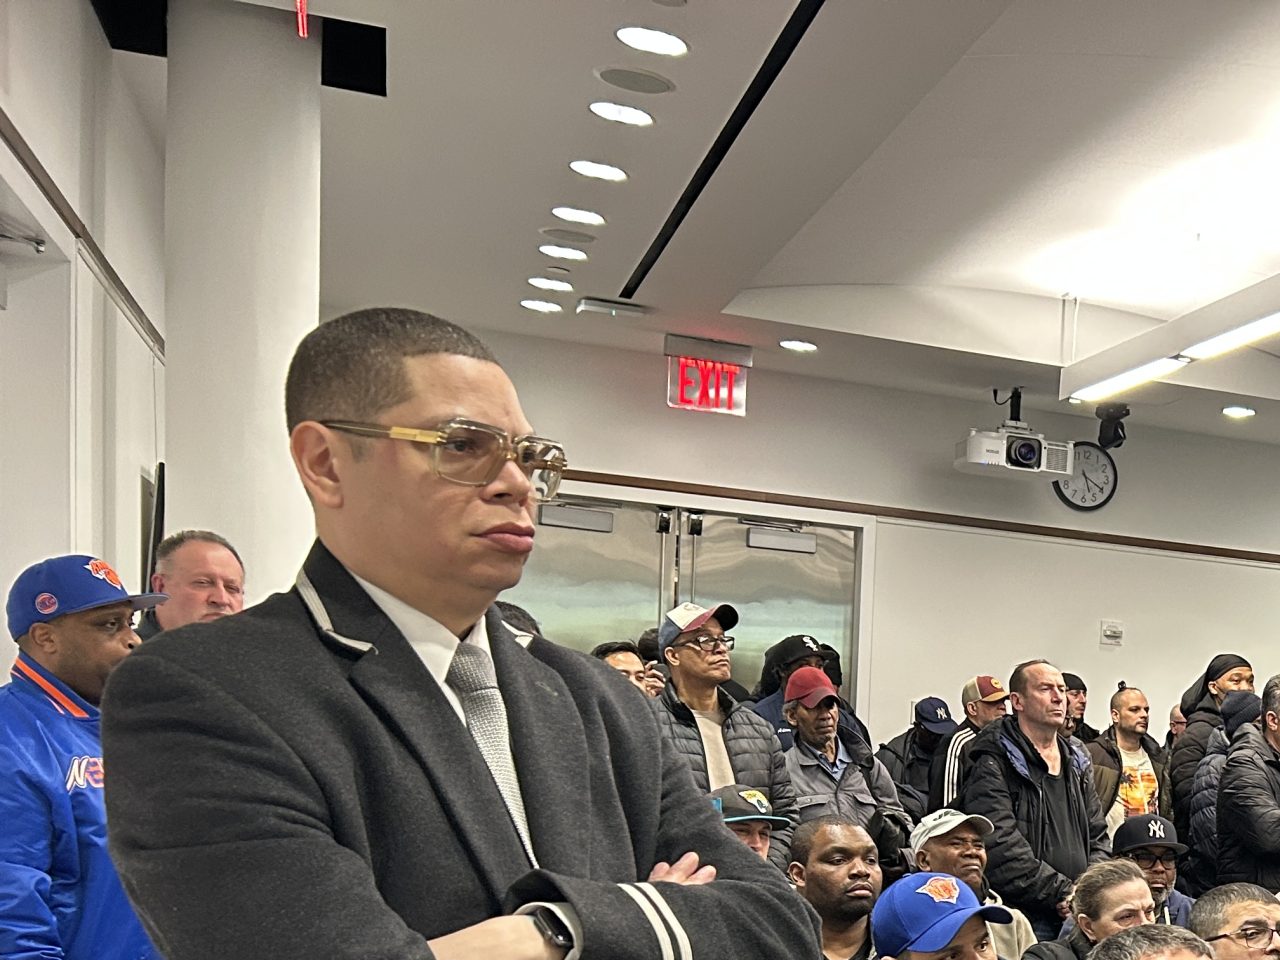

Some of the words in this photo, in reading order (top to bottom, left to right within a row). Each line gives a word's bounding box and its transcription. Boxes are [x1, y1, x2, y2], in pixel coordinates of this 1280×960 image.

[678, 356, 740, 411] EXIT
[1083, 450, 1091, 460] 12
[1101, 464, 1107, 473] 2
[1063, 480, 1069, 489] 8
[1103, 475, 1109, 485] 3
[1148, 820, 1165, 838] NY
